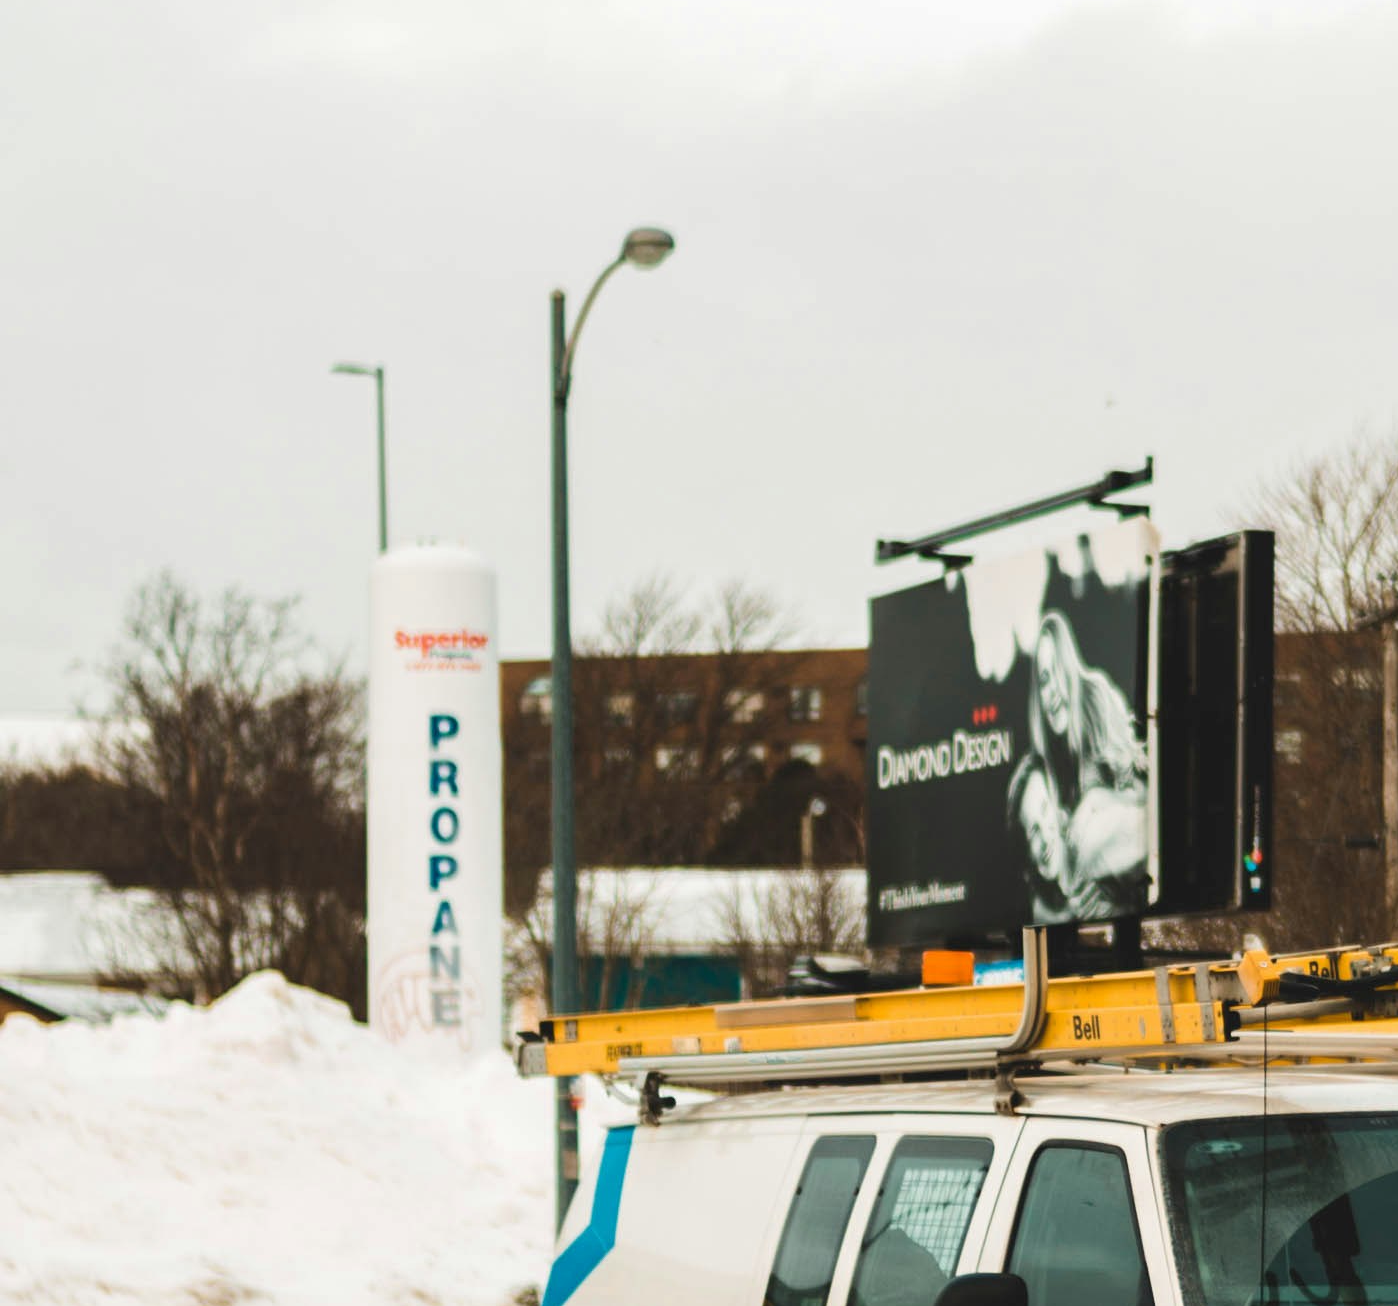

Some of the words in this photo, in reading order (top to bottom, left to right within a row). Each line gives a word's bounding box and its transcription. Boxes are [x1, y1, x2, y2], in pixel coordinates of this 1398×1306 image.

[394, 629, 488, 659] Superior
[428, 713, 462, 1028] PROPANE
[1072, 1014, 1101, 1040] Bell
